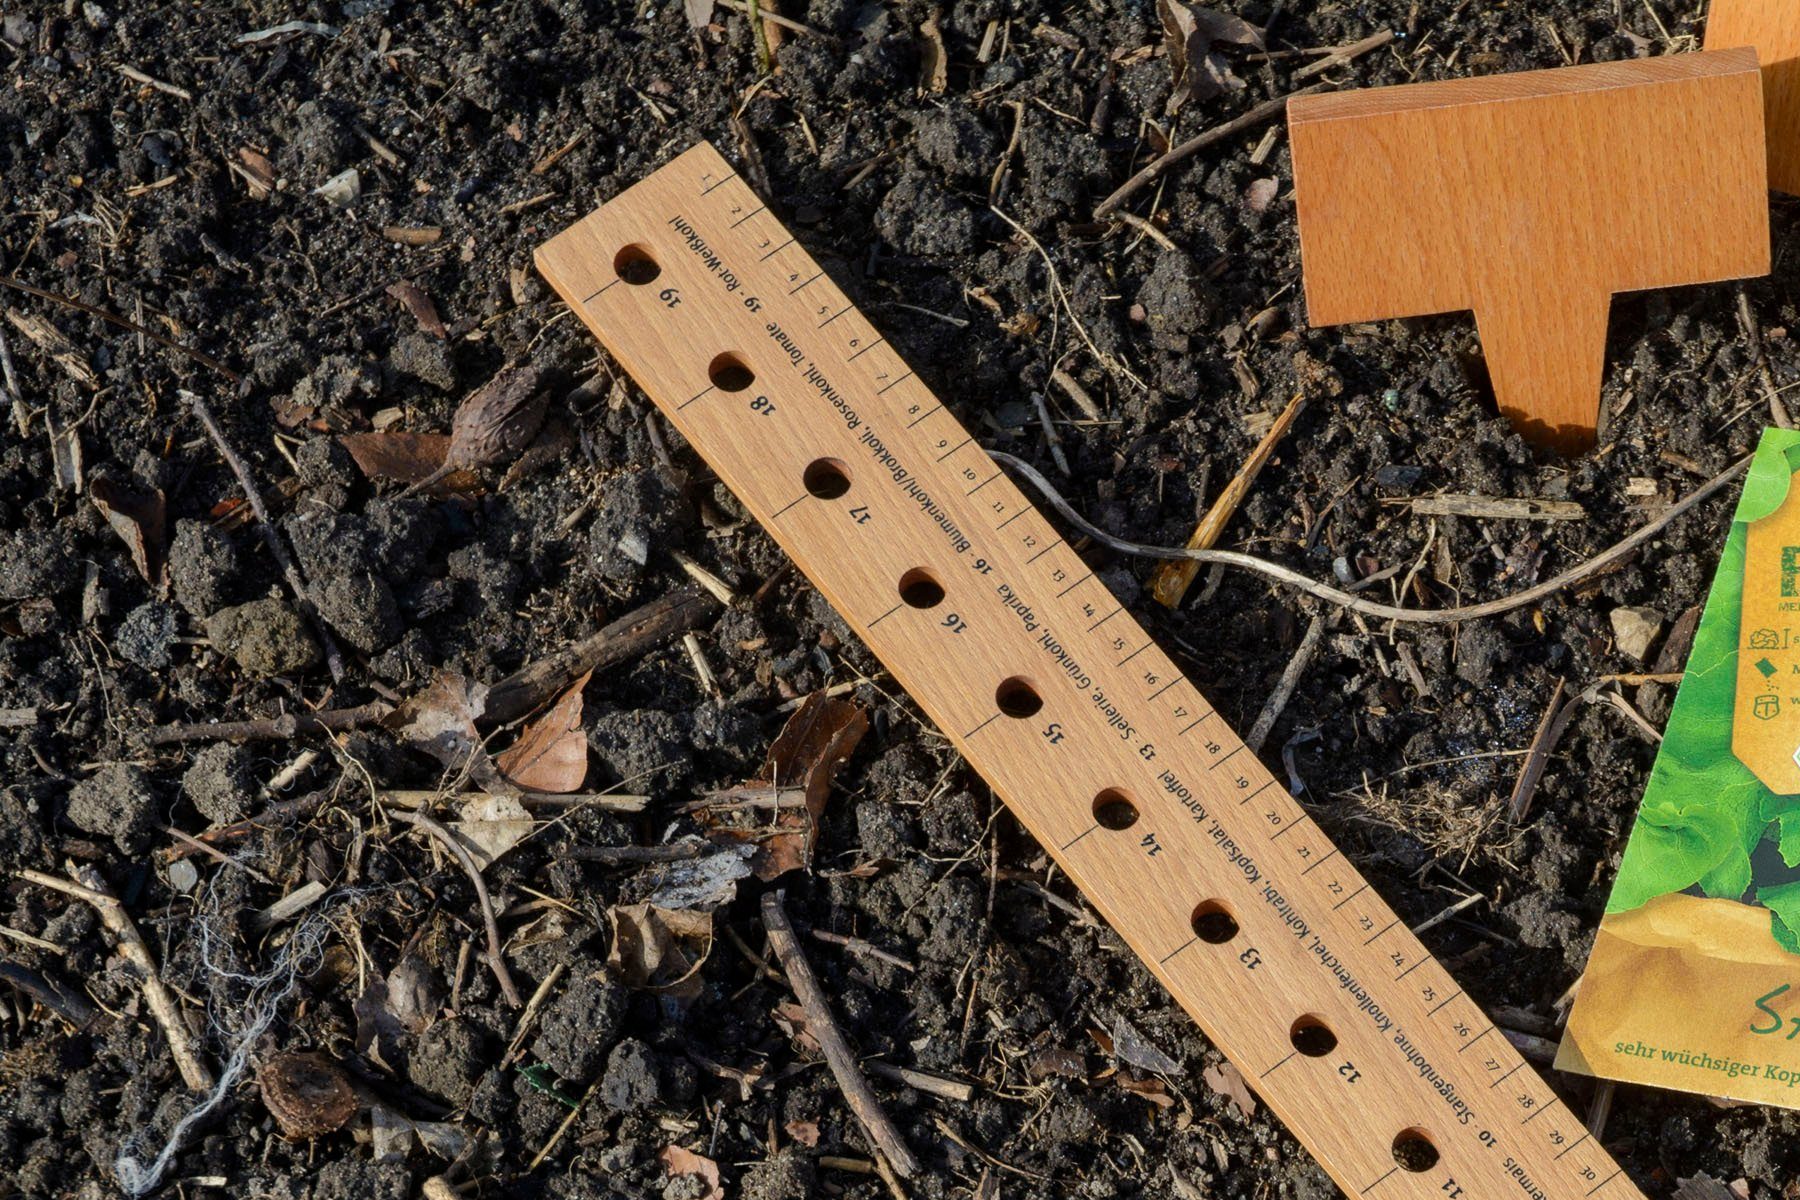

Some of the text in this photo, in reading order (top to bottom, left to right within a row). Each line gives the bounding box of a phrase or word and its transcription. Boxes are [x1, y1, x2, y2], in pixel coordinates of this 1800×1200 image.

[666, 213, 742, 293] Rot-Weißkohl
[658, 287, 682, 310] 19
[743, 296, 763, 314] 19
[764, 321, 806, 369] Tomate
[748, 394, 777, 417] 18
[801, 361, 863, 431] Rosenkohl,
[857, 425, 972, 555] Blumenkohl/Brokkoli,
[847, 504, 873, 526] 17
[971, 557, 994, 576] 16
[939, 612, 969, 635] 16
[995, 582, 1041, 633] Paprika
[1035, 627, 1092, 691] Grünkohl,
[1091, 686, 1138, 741] Sellerie,
[1041, 722, 1066, 746] 15
[1137, 742, 1157, 762] 13
[1156, 768, 1211, 825] Kartoffel
[961, 466, 977, 482] 10
[991, 500, 1006, 514] 11
[1021, 534, 1037, 549] 12
[1051, 567, 1067, 583] 13
[1081, 602, 1096, 619] 14
[1111, 636, 1126, 651] 15
[1142, 671, 1160, 686] 16
[1173, 705, 1189, 719] 17
[1203, 739, 1222, 755] 18
[1234, 775, 1251, 790] 19
[1264, 809, 1282, 826] 20
[1296, 845, 1312, 860] 21
[1326, 879, 1344, 896] 22
[1358, 914, 1375, 932] 23
[1389, 950, 1406, 969] 24
[1421, 985, 1437, 1003] 25
[1452, 1021, 1472, 1038] 26
[1484, 1057, 1502, 1072] 27
[1516, 1093, 1536, 1110] 28
[1548, 1129, 1565, 1146] 29
[1577, 1164, 1597, 1182] 30
[1139, 832, 1163, 858] 14
[1206, 818, 1263, 886] Kopfsalat,
[1257, 879, 1312, 941] Kohlrabi,
[1238, 946, 1263, 971] 13
[1306, 934, 1394, 1034] Knollenfenchel,
[1337, 1060, 1363, 1085] 12
[1392, 1028, 1476, 1126] Stangenbohne,
[1614, 1040, 1657, 1060] sehr
[1660, 1048, 1761, 1079] wüchsiger
[1477, 1129, 1498, 1149] 10
[1440, 1177, 1465, 1200] 11
